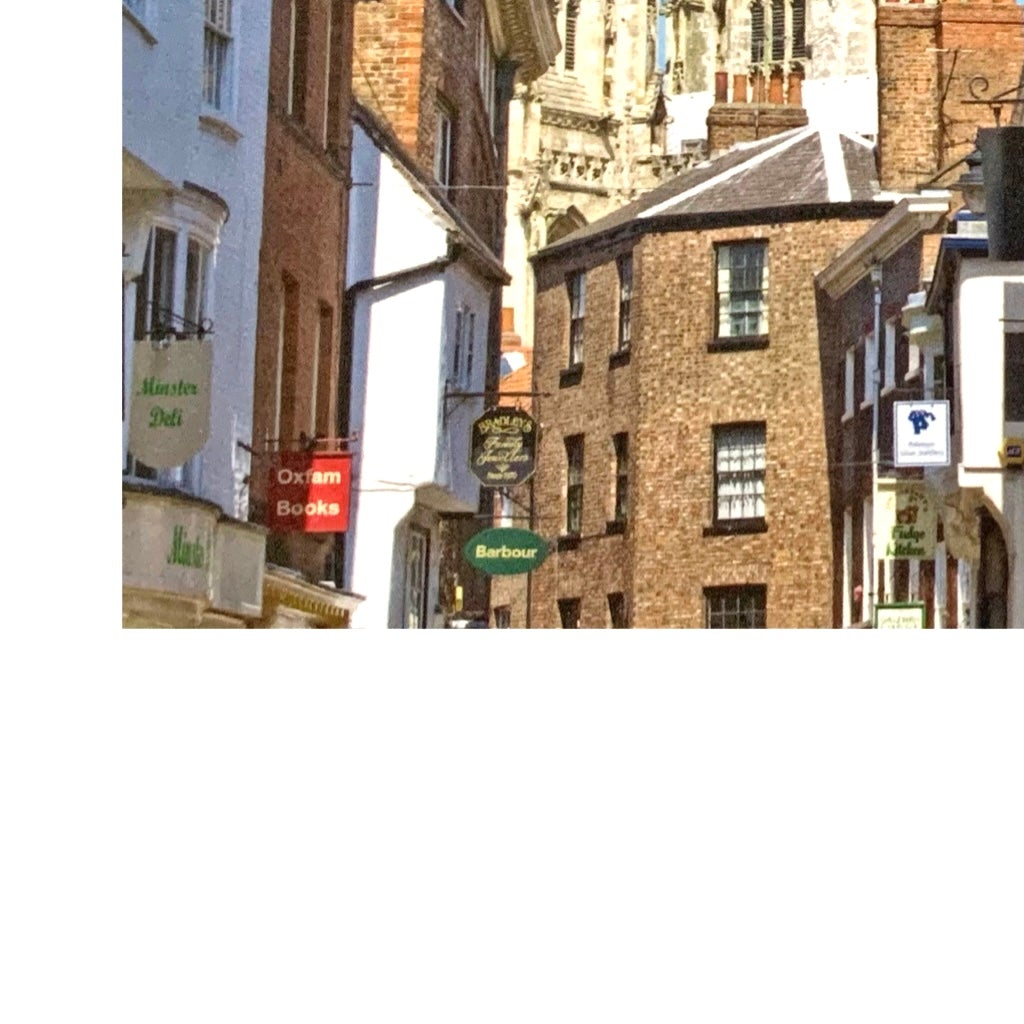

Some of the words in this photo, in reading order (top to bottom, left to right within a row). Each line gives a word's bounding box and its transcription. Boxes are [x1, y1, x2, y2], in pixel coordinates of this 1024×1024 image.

[136, 376, 197, 396] Minster
[149, 406, 183, 428] Deli
[277, 469, 341, 484] Oxfam
[276, 500, 340, 516] Books
[475, 544, 538, 558] Barbour
